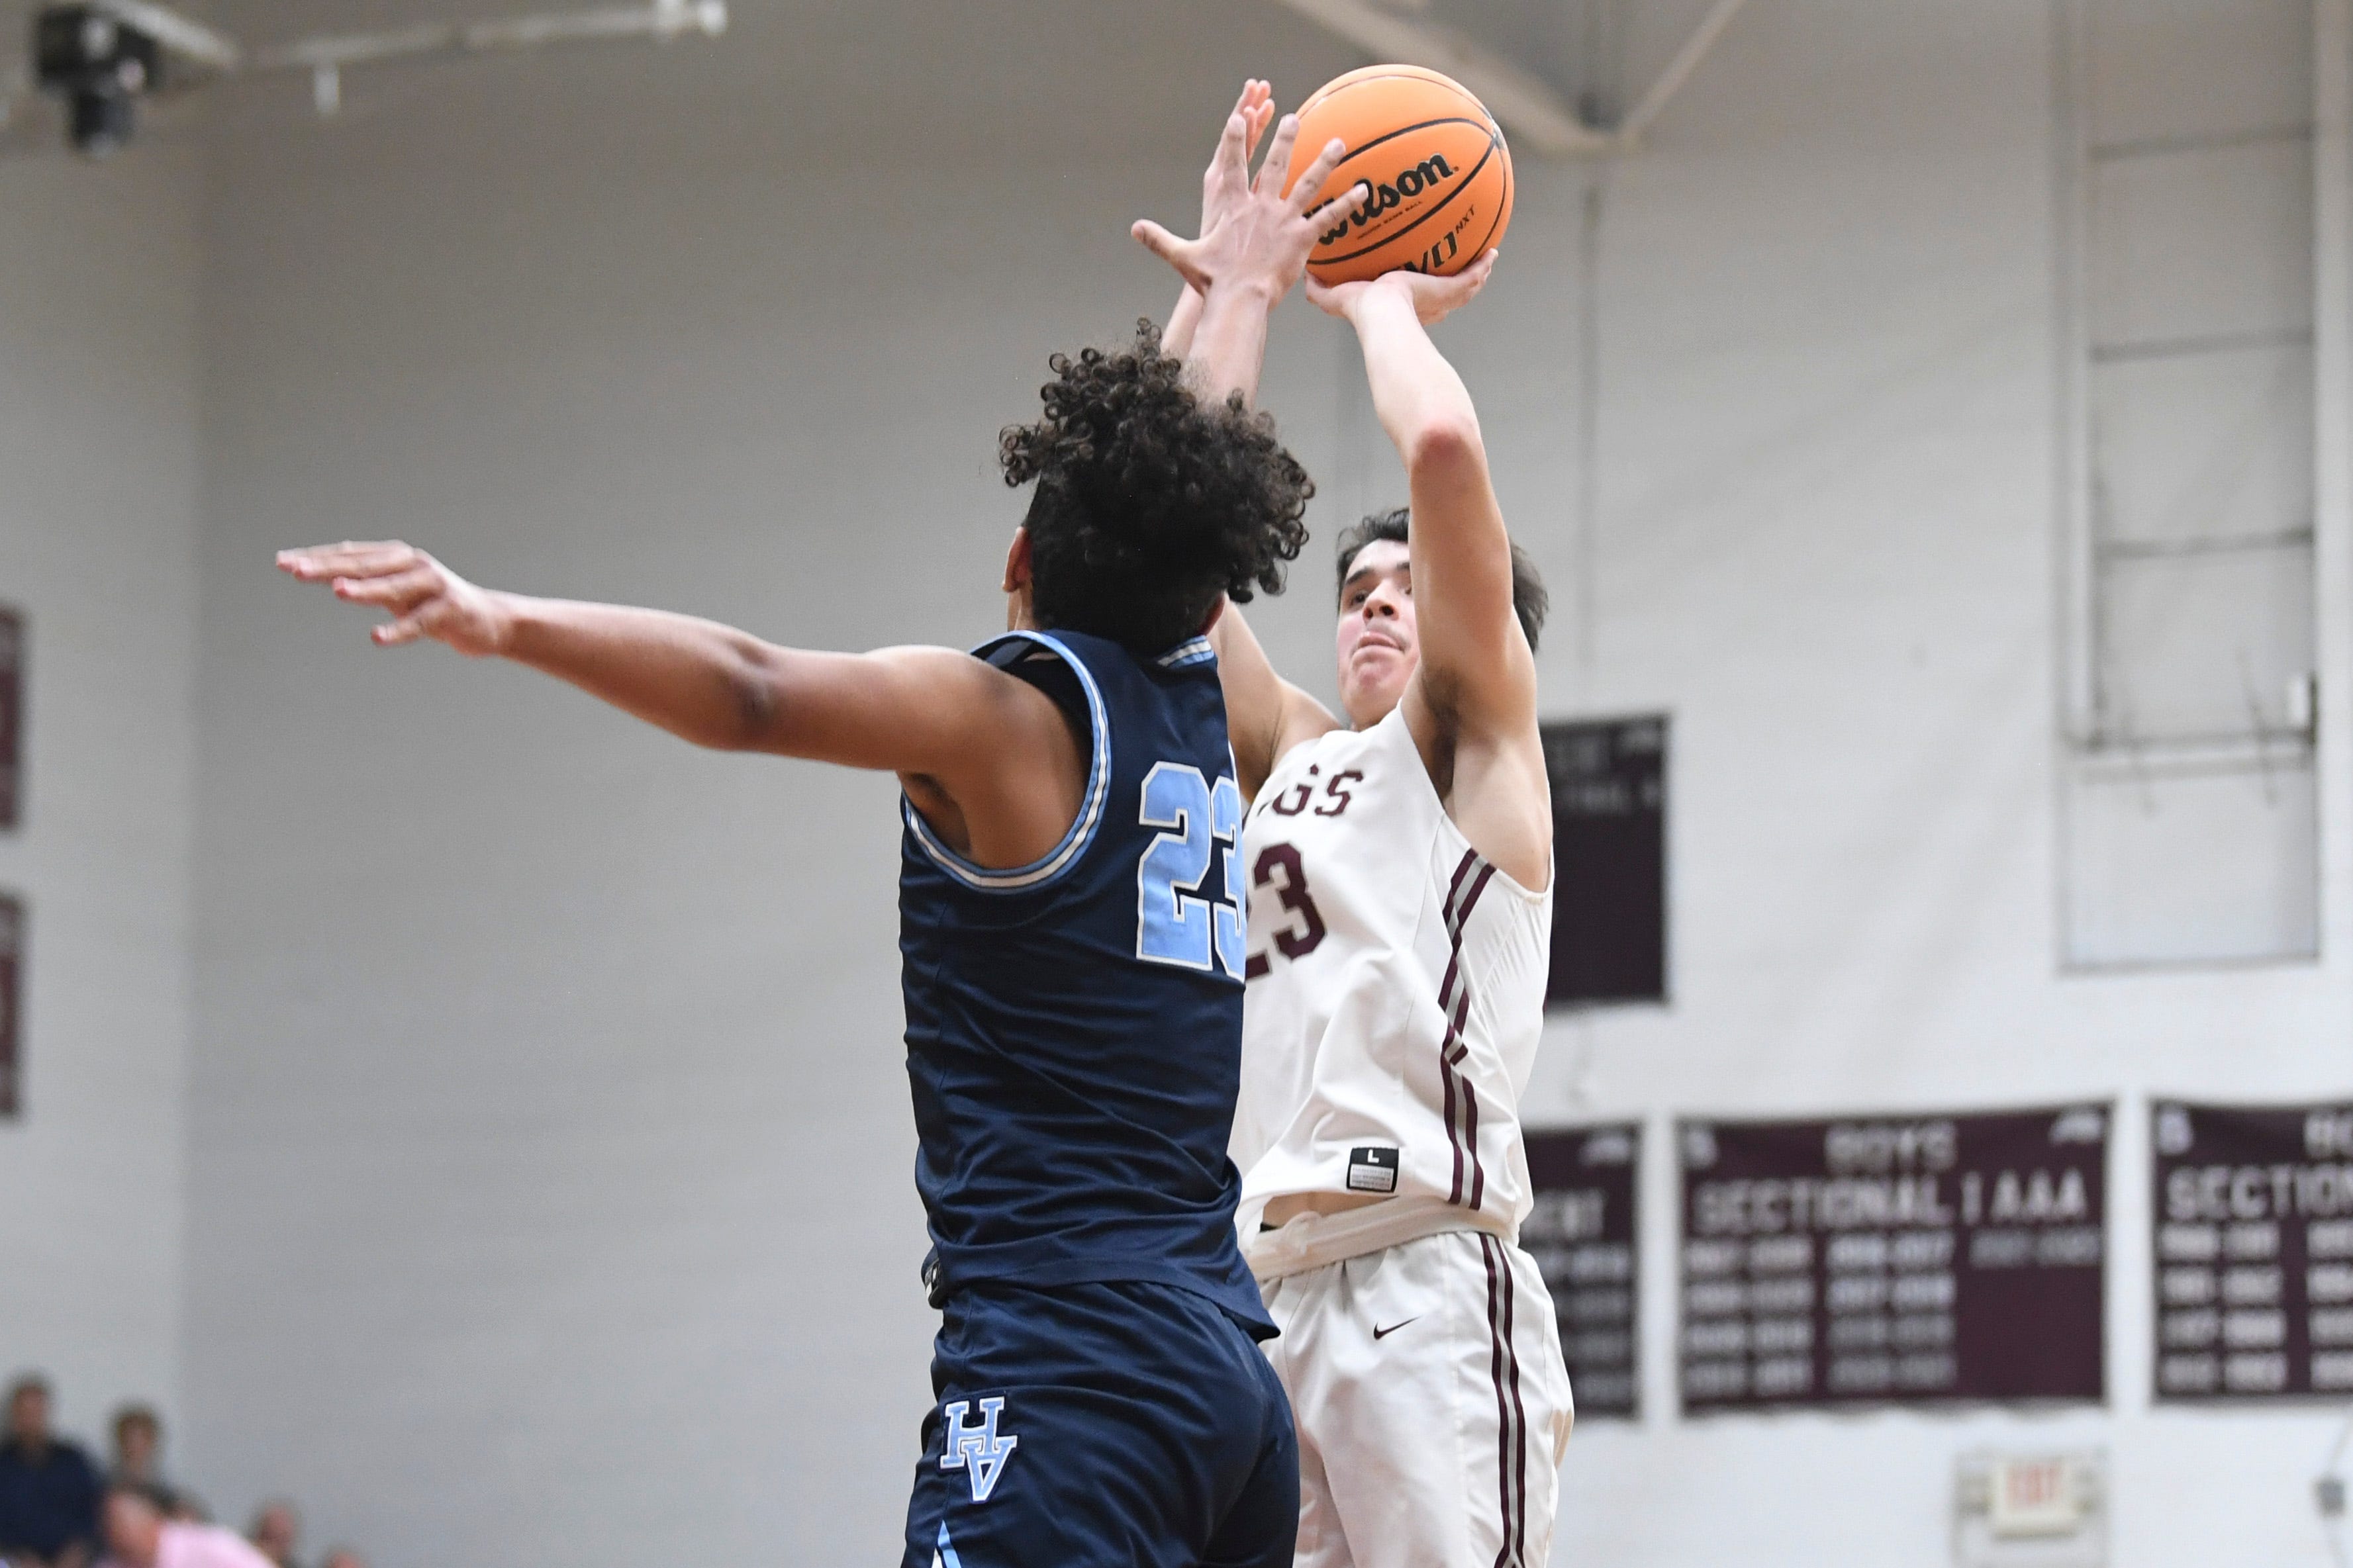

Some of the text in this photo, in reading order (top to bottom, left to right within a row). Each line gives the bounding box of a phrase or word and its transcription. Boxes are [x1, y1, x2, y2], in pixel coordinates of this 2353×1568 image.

[1390, 231, 1458, 273] VO
[1455, 204, 1474, 234] NXT
[1258, 764, 1363, 816] GS
[1246, 843, 1327, 980] 3
[1367, 1149, 1380, 1163] L
[1992, 1168, 2086, 1223] AAA
